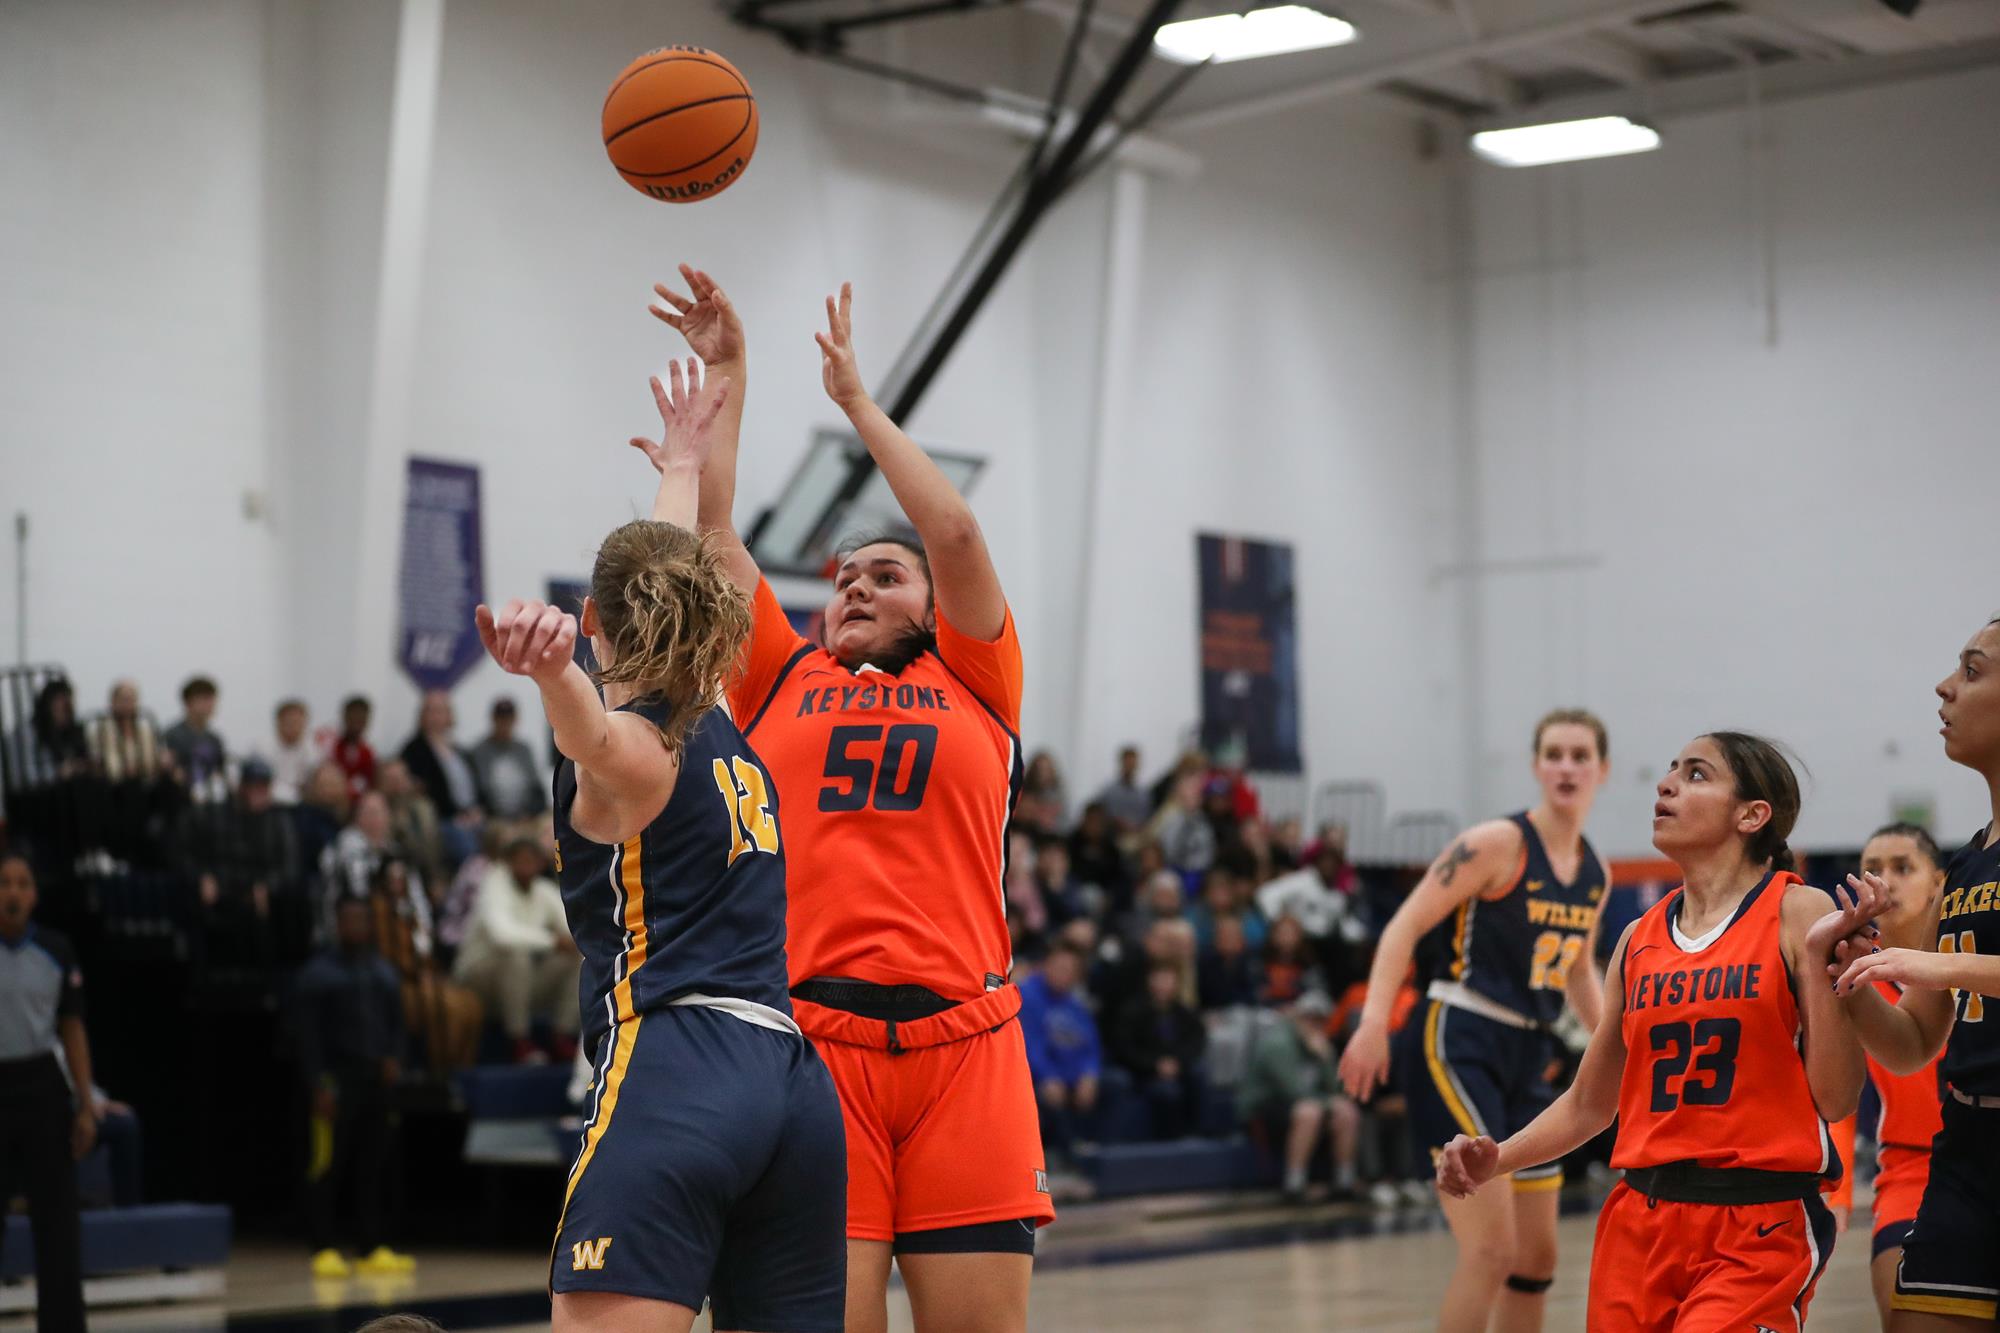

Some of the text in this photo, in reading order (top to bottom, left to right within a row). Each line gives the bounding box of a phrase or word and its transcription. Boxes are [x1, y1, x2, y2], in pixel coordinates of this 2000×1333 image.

[644, 156, 744, 200] Wilson
[796, 683, 951, 719] KEYSTONE
[817, 723, 939, 813] 50
[712, 755, 779, 869] 12
[1649, 1016, 1742, 1113] 23
[572, 1236, 613, 1271] W
